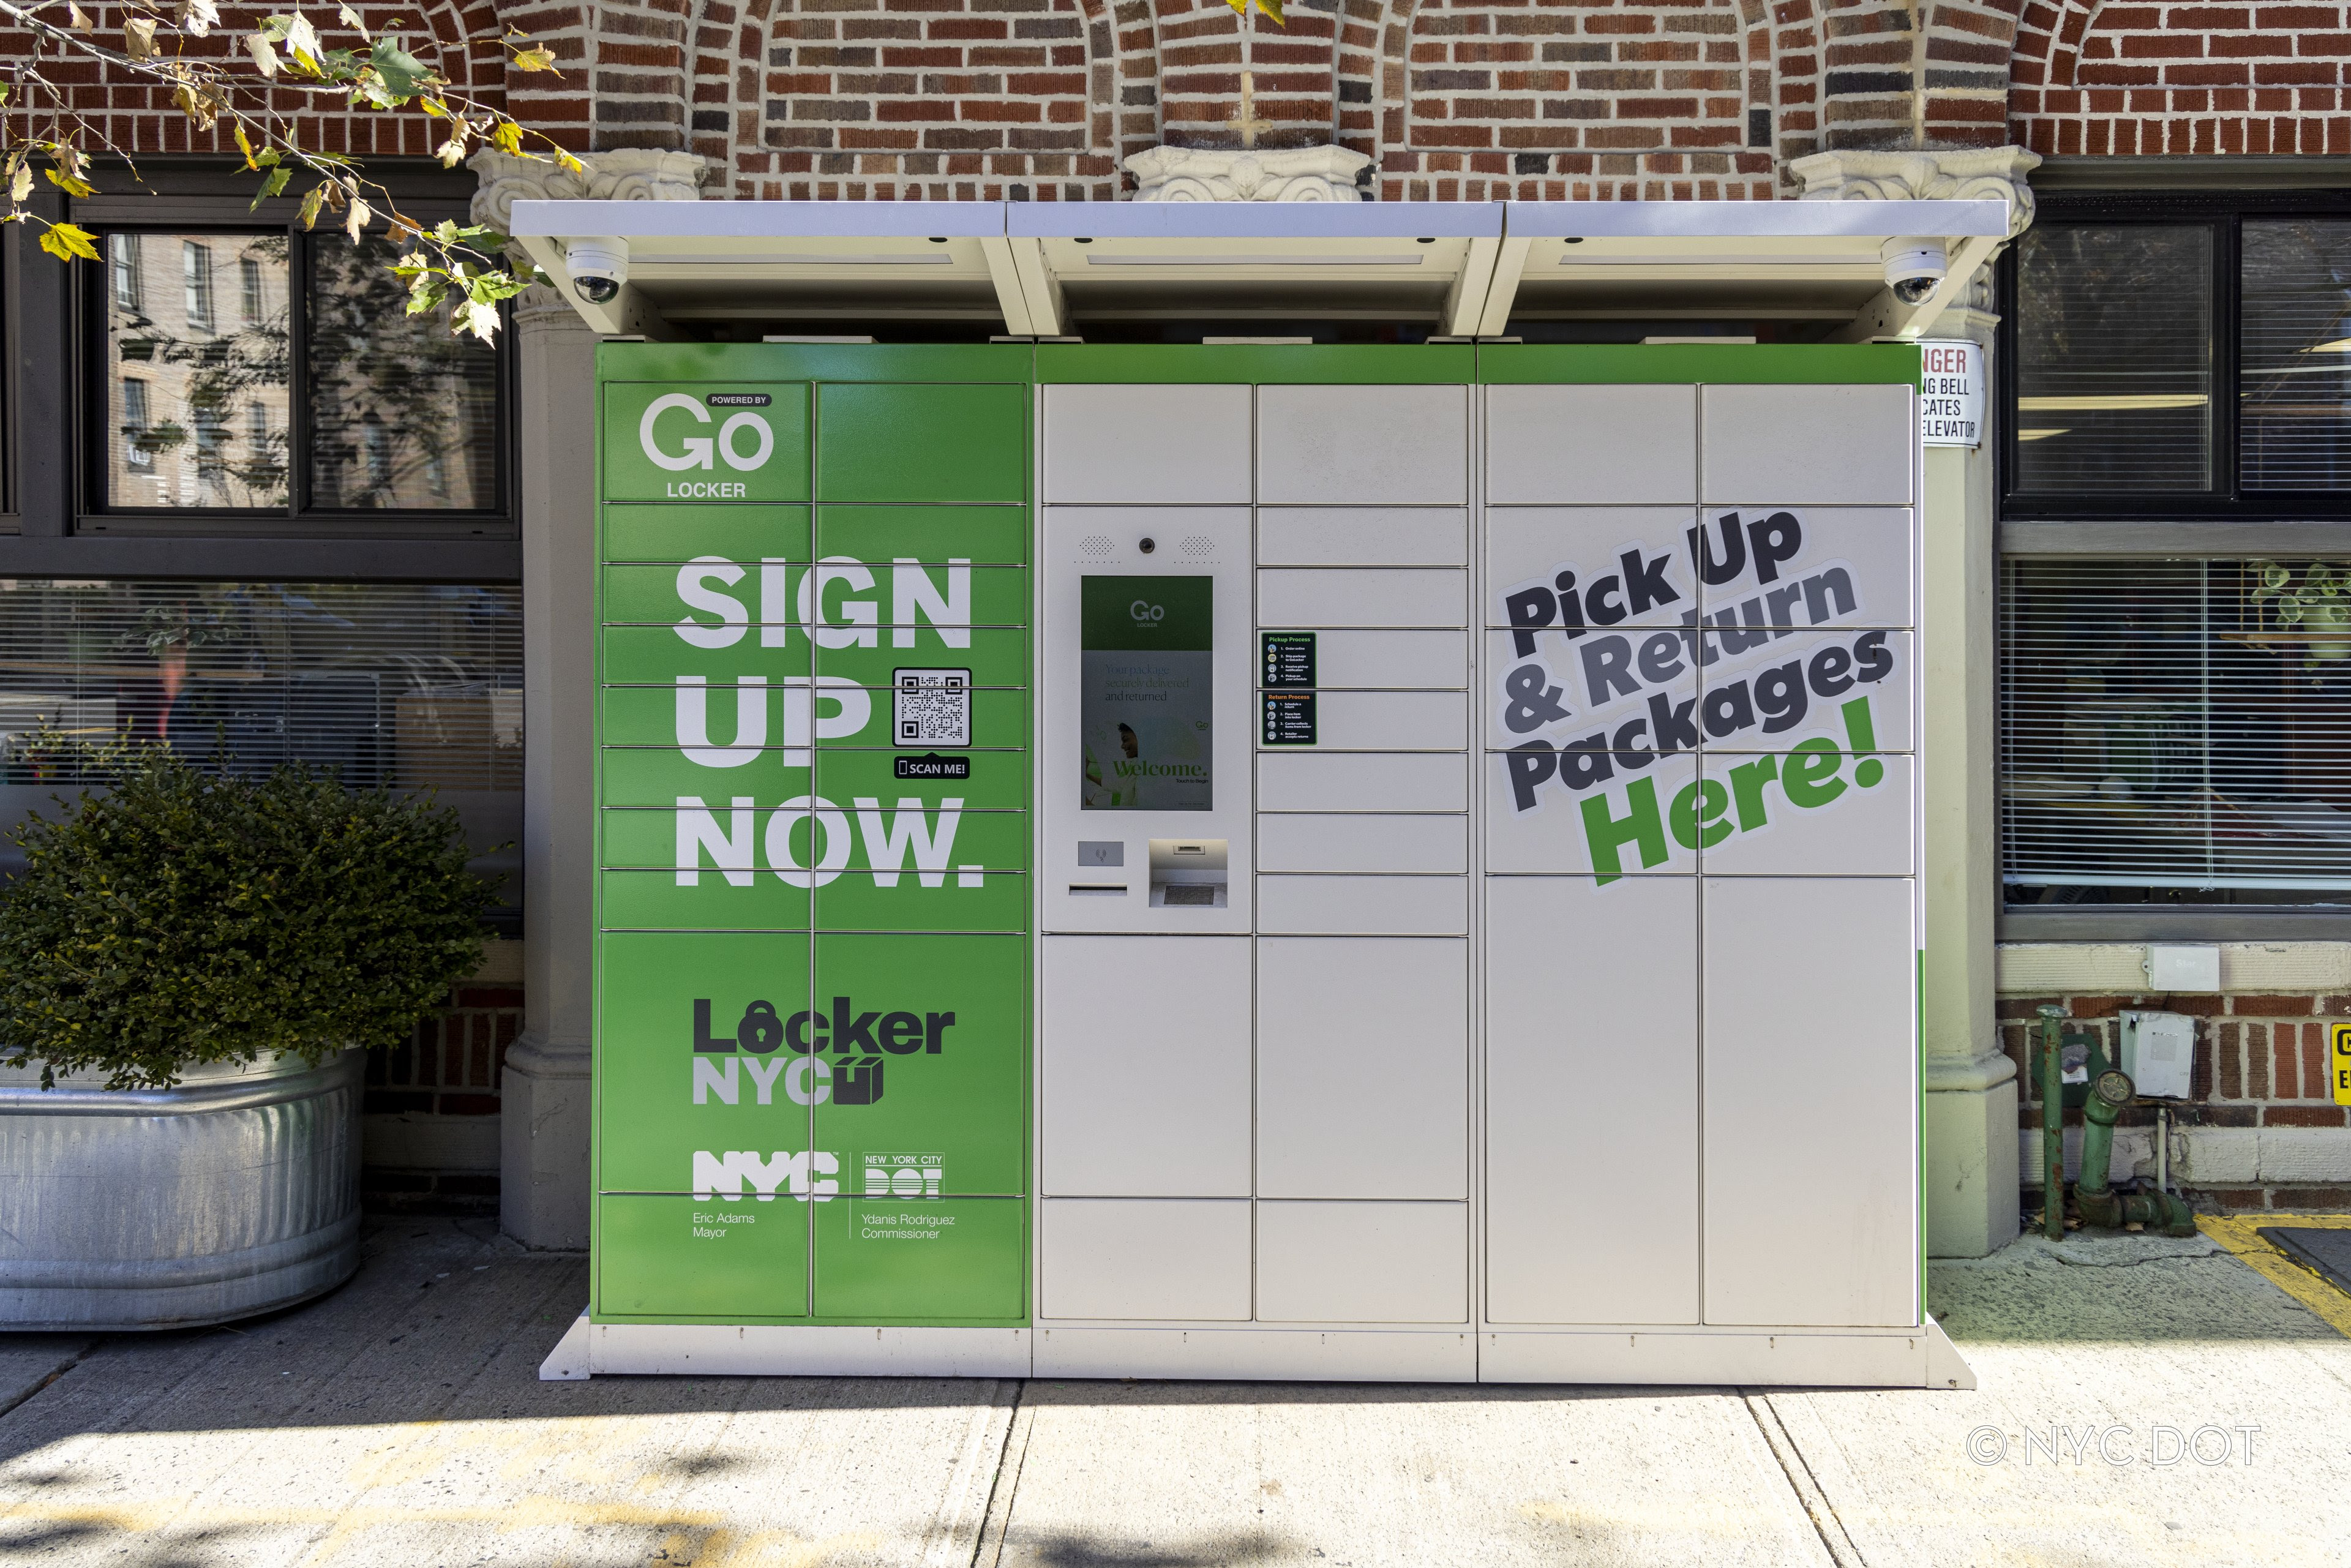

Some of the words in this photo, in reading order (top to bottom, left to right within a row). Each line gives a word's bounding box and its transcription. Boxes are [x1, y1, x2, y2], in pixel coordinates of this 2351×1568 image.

[1922, 348, 1967, 373] GER
[1940, 378, 1970, 396] BELL
[1922, 399, 1961, 416] CATES
[667, 482, 746, 498] LOCKER
[1505, 548, 1682, 659] Pick
[1686, 511, 1802, 586] Up
[672, 555, 971, 650] SIGN
[1504, 663, 1572, 734] &
[1579, 566, 1858, 708] Return
[1130, 664, 1171, 677] package
[1105, 677, 1145, 689] securely
[1146, 677, 1190, 688] delivered
[1105, 691, 1123, 701] and
[1125, 691, 1167, 701] returned
[675, 675, 872, 768] UP
[1505, 631, 1894, 813] Packages
[909, 763, 941, 774] SCAN
[944, 764, 966, 774] ME!
[1112, 760, 1208, 777] Welcome.
[1579, 695, 1884, 888] Here!
[675, 795, 984, 888] NOW.
[692, 1056, 831, 1106] NYC
[865, 1155, 887, 1164] NEW
[892, 1155, 917, 1164] YORK
[921, 1155, 942, 1164] CITY
[865, 1168, 942, 1199] DOT
[693, 1212, 714, 1223] Eric
[716, 1213, 755, 1223] Adams
[861, 1214, 897, 1225] Ydanis
[900, 1214, 955, 1228] Rodriguez
[693, 1226, 727, 1240] Mayor
[861, 1228, 940, 1239] Commissioner
